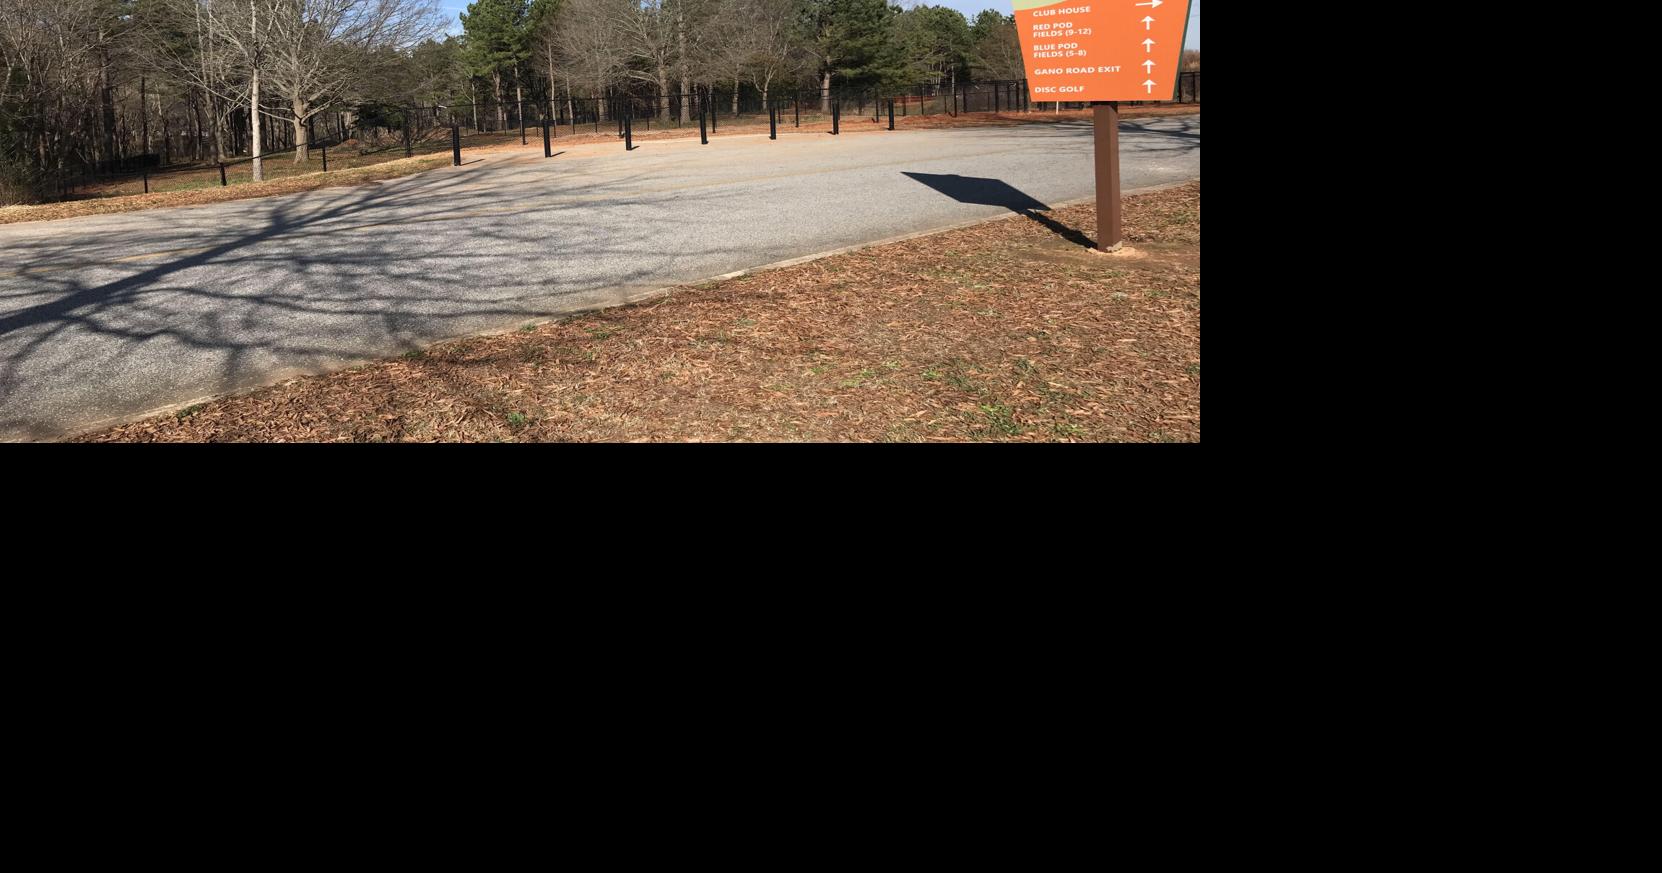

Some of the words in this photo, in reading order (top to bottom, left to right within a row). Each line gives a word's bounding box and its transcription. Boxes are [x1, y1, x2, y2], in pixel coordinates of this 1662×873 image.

[1033, 9, 1056, 17] CLUB
[1058, 6, 1091, 14] HOUSE
[1033, 23, 1051, 31] RED
[1033, 30, 1063, 38] FIELDS
[1065, 28, 1092, 36] (9-12)
[1057, 42, 1078, 50] POD
[1033, 50, 1064, 58] FIELDS
[1065, 49, 1087, 57] (5-8)
[1065, 66, 1095, 74] ROAD
[1098, 65, 1121, 73] EXIT
[1059, 85, 1084, 93] GOLF
